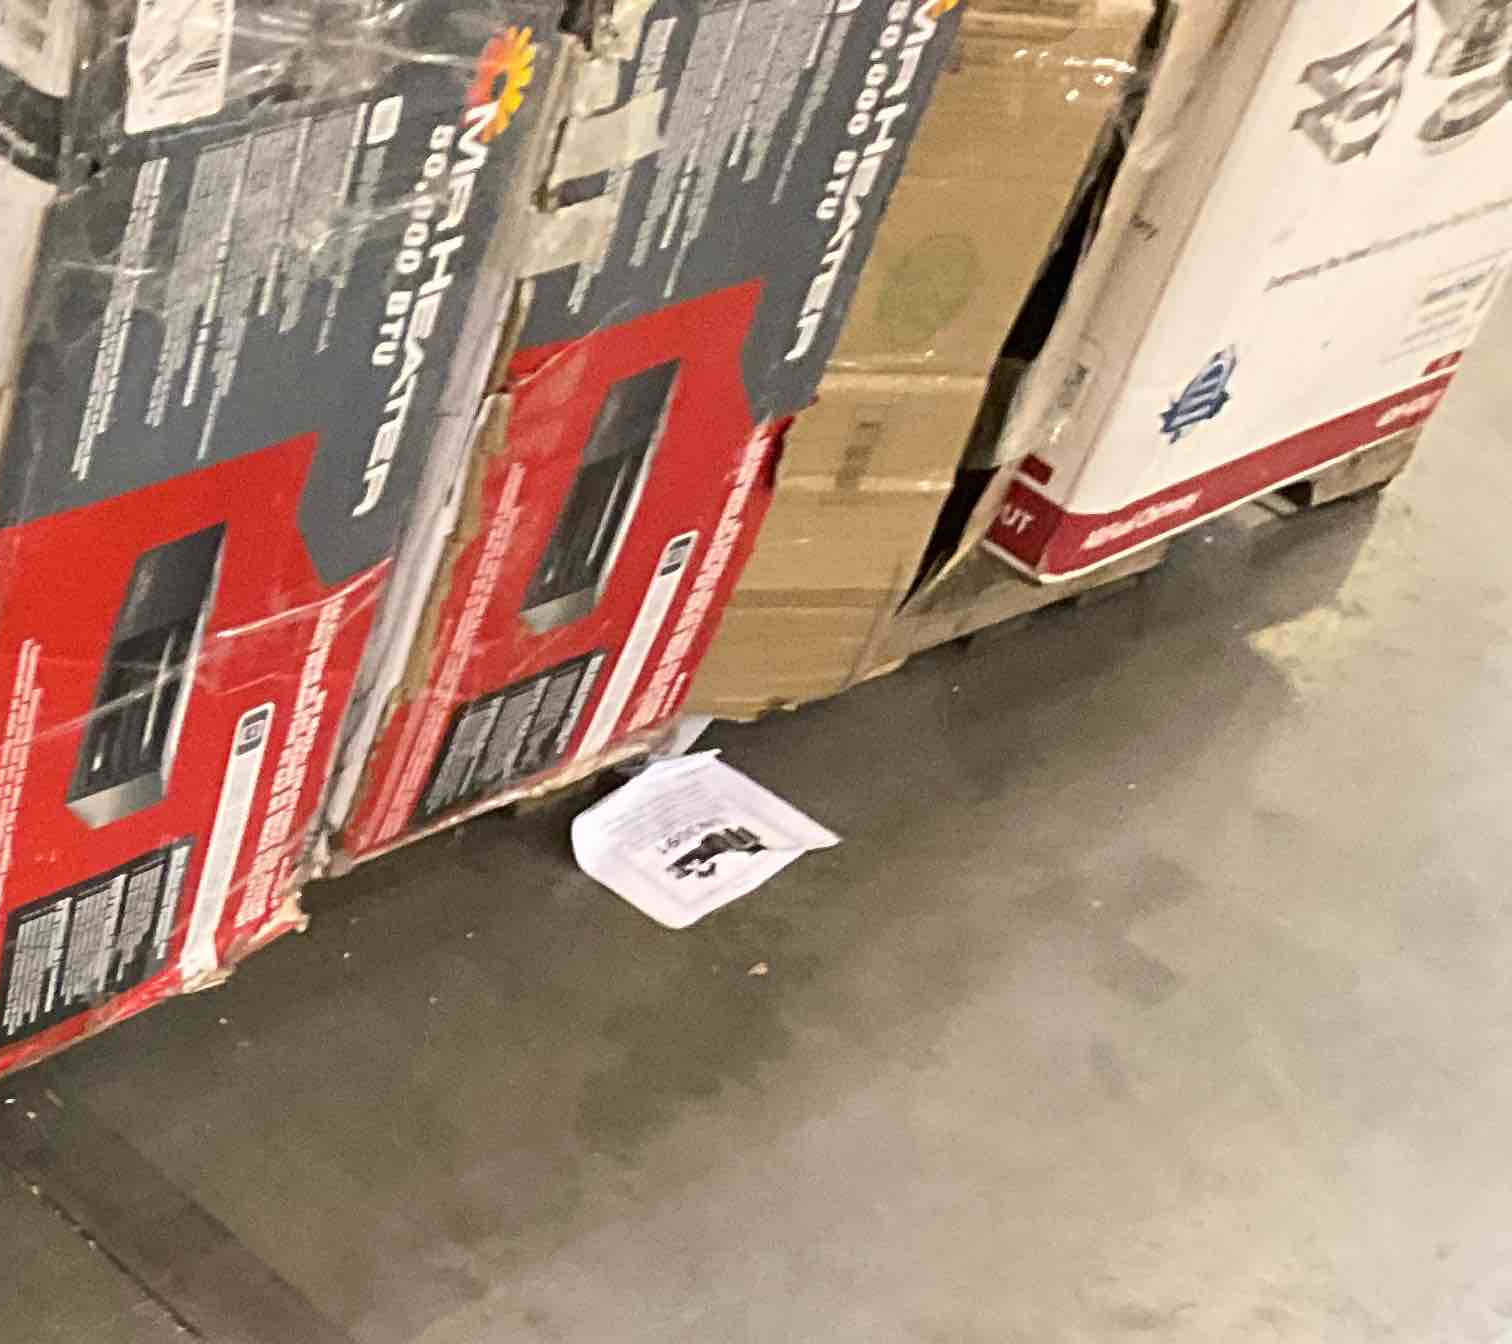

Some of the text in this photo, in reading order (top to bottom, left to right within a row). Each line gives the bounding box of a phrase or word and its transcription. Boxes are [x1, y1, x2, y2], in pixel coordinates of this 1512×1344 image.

[815, 150, 858, 220] BTU
[371, 290, 414, 367] BTU
[351, 234, 465, 518] HEATER
